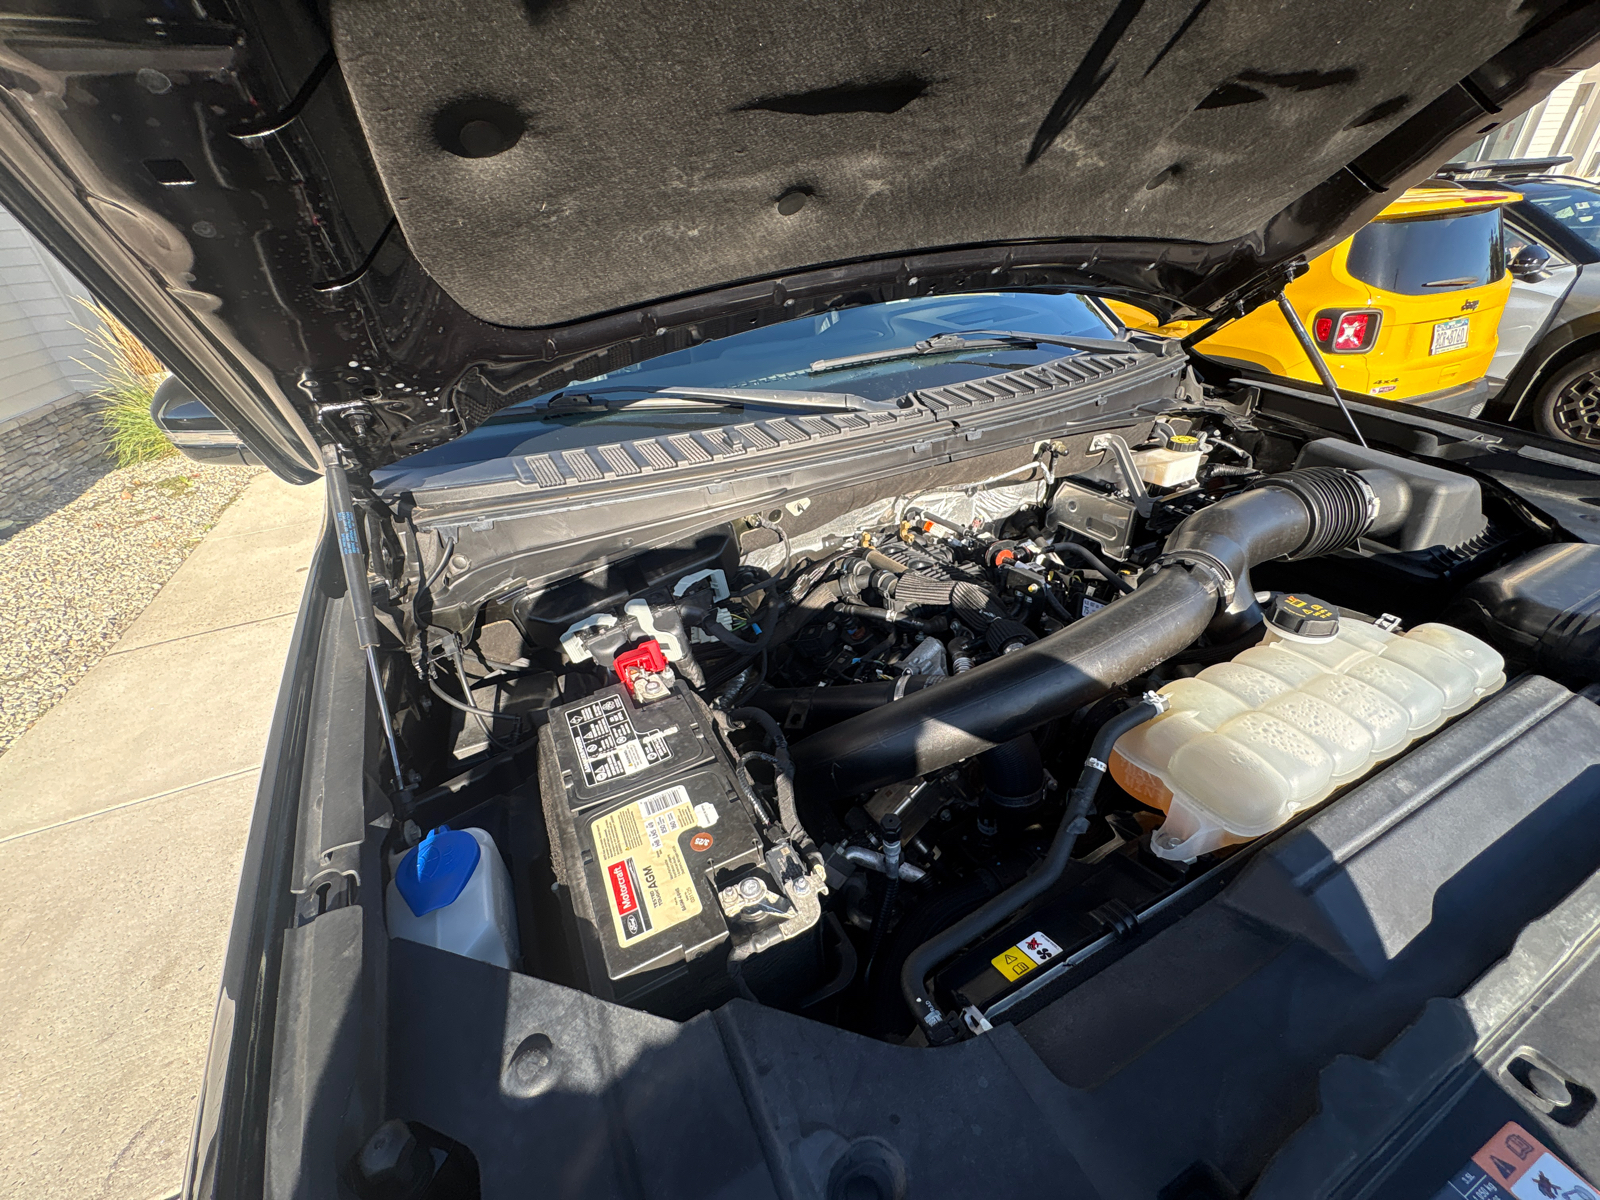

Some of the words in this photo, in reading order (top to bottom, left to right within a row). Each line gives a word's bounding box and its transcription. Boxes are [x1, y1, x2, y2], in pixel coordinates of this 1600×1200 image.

[695, 838, 709, 846] 3/25
[613, 865, 631, 909] Motorcraft
[642, 865, 657, 889] AGM
[627, 914, 638, 934] Ford
